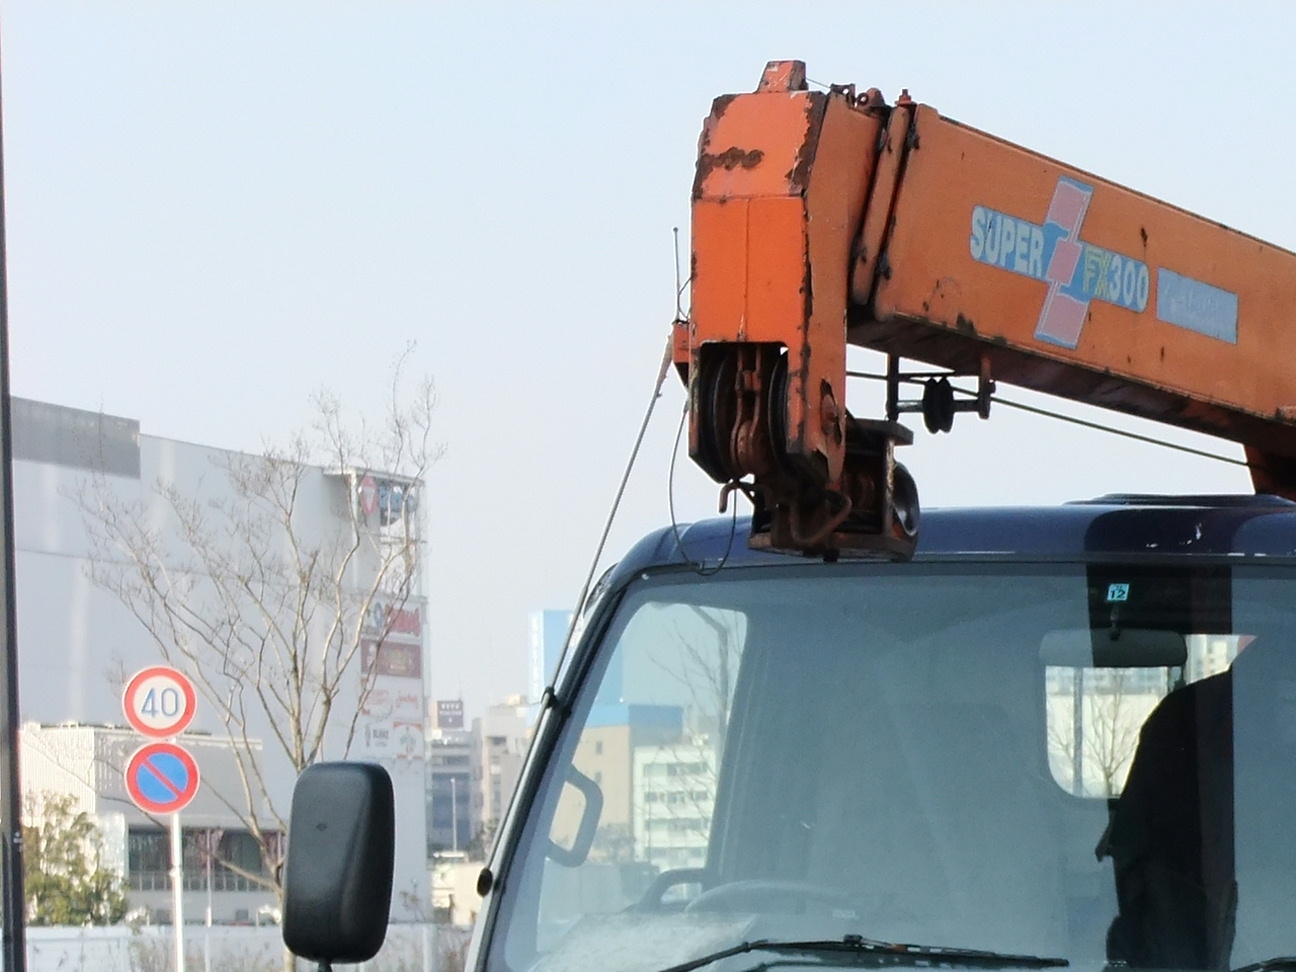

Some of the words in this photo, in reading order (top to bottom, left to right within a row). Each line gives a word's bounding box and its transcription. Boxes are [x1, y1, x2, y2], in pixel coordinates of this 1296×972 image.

[970, 205, 1044, 277] SUPER
[1110, 590, 1126, 599] 12
[141, 688, 179, 717] 40
